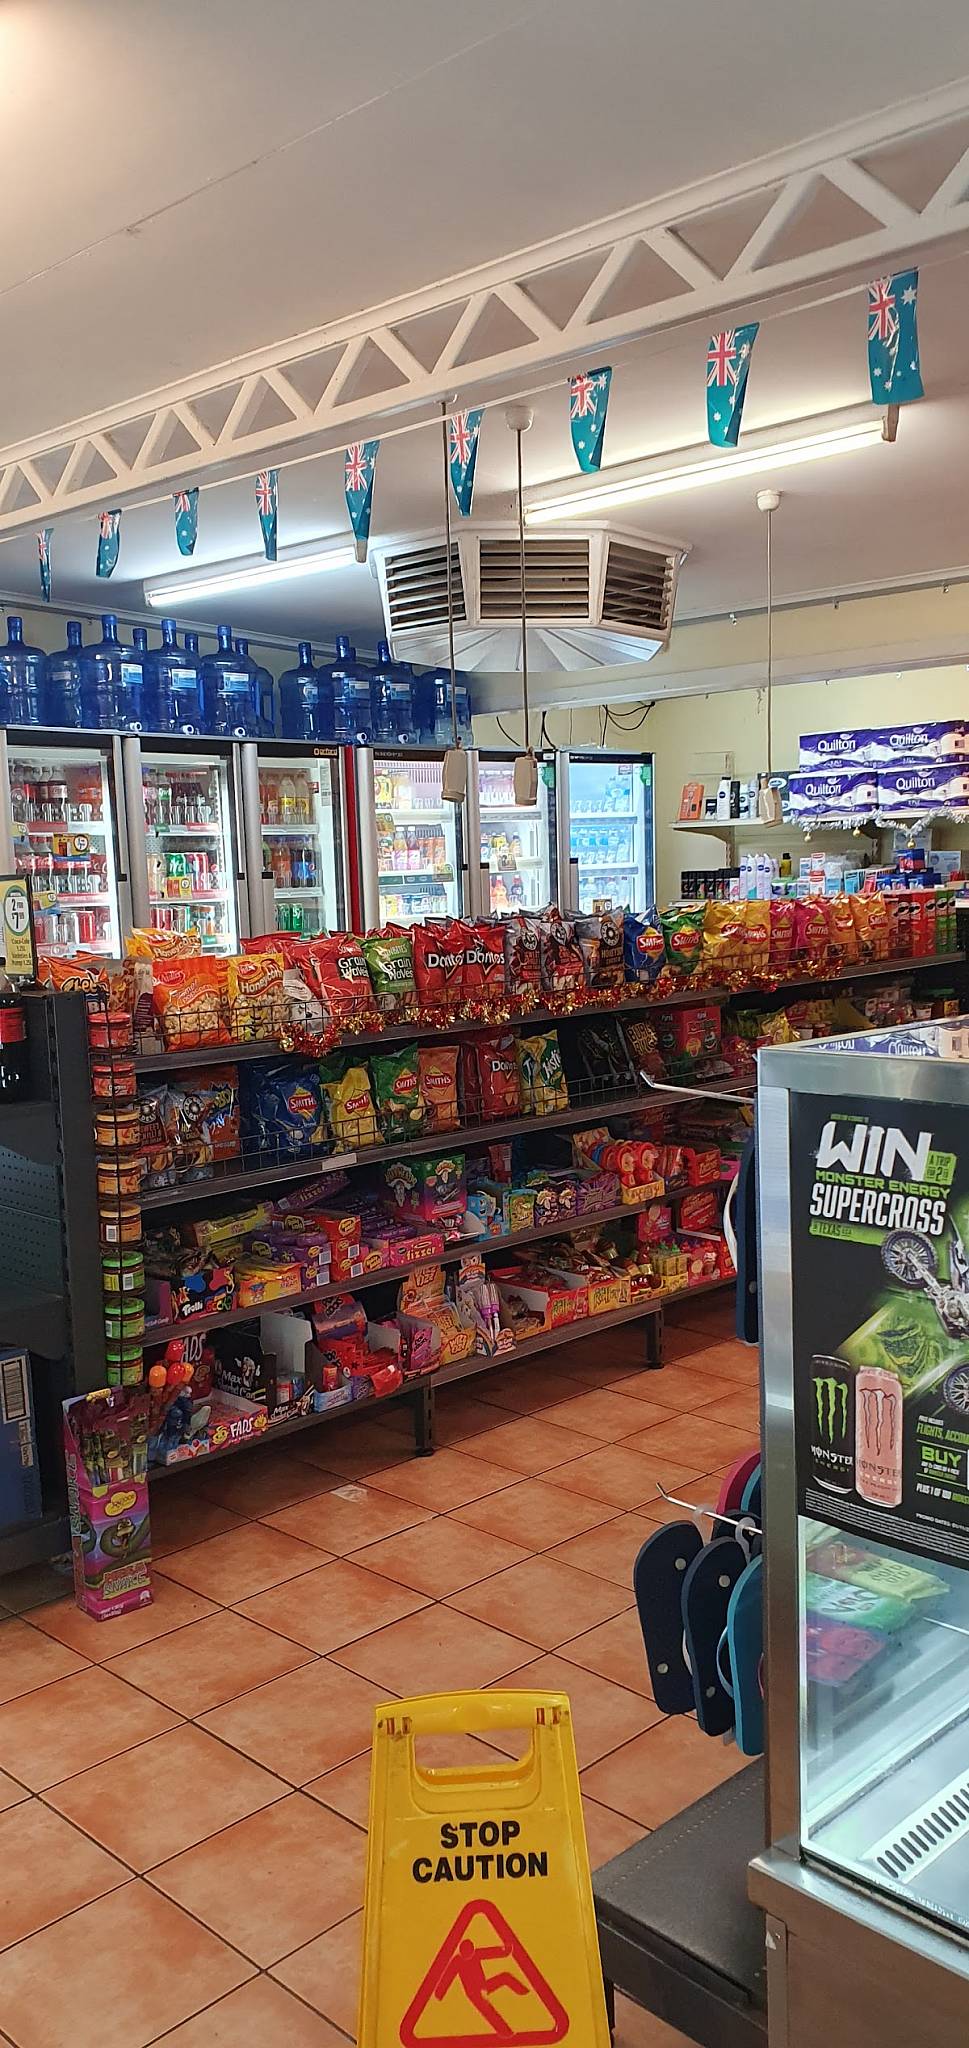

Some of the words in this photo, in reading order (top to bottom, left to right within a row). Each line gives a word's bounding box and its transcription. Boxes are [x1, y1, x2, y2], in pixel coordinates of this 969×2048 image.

[818, 739, 856, 754] Quilton
[890, 734, 928, 747] Quilton
[806, 784, 841, 797] Quilton
[896, 777, 934, 792] Quilton
[382, 958, 412, 971] Grain
[816, 1120, 934, 1182] WIN
[935, 1166, 943, 1182] 2
[815, 1169, 885, 1189] MONSTER
[888, 1180, 951, 1199] ENERGY
[809, 1182, 947, 1236] SUPERCROSS
[818, 1221, 841, 1236] TEXAS
[182, 1301, 204, 1317] Trolli
[181, 1332, 206, 1363] ADS
[230, 1417, 254, 1438] FADS
[916, 1422, 944, 1440] FLIGHTS,
[921, 1446, 962, 1468] BUY
[916, 1482, 930, 1495] PLUS
[440, 1820, 522, 1850] STOP
[411, 1852, 549, 1884] CAUTION
